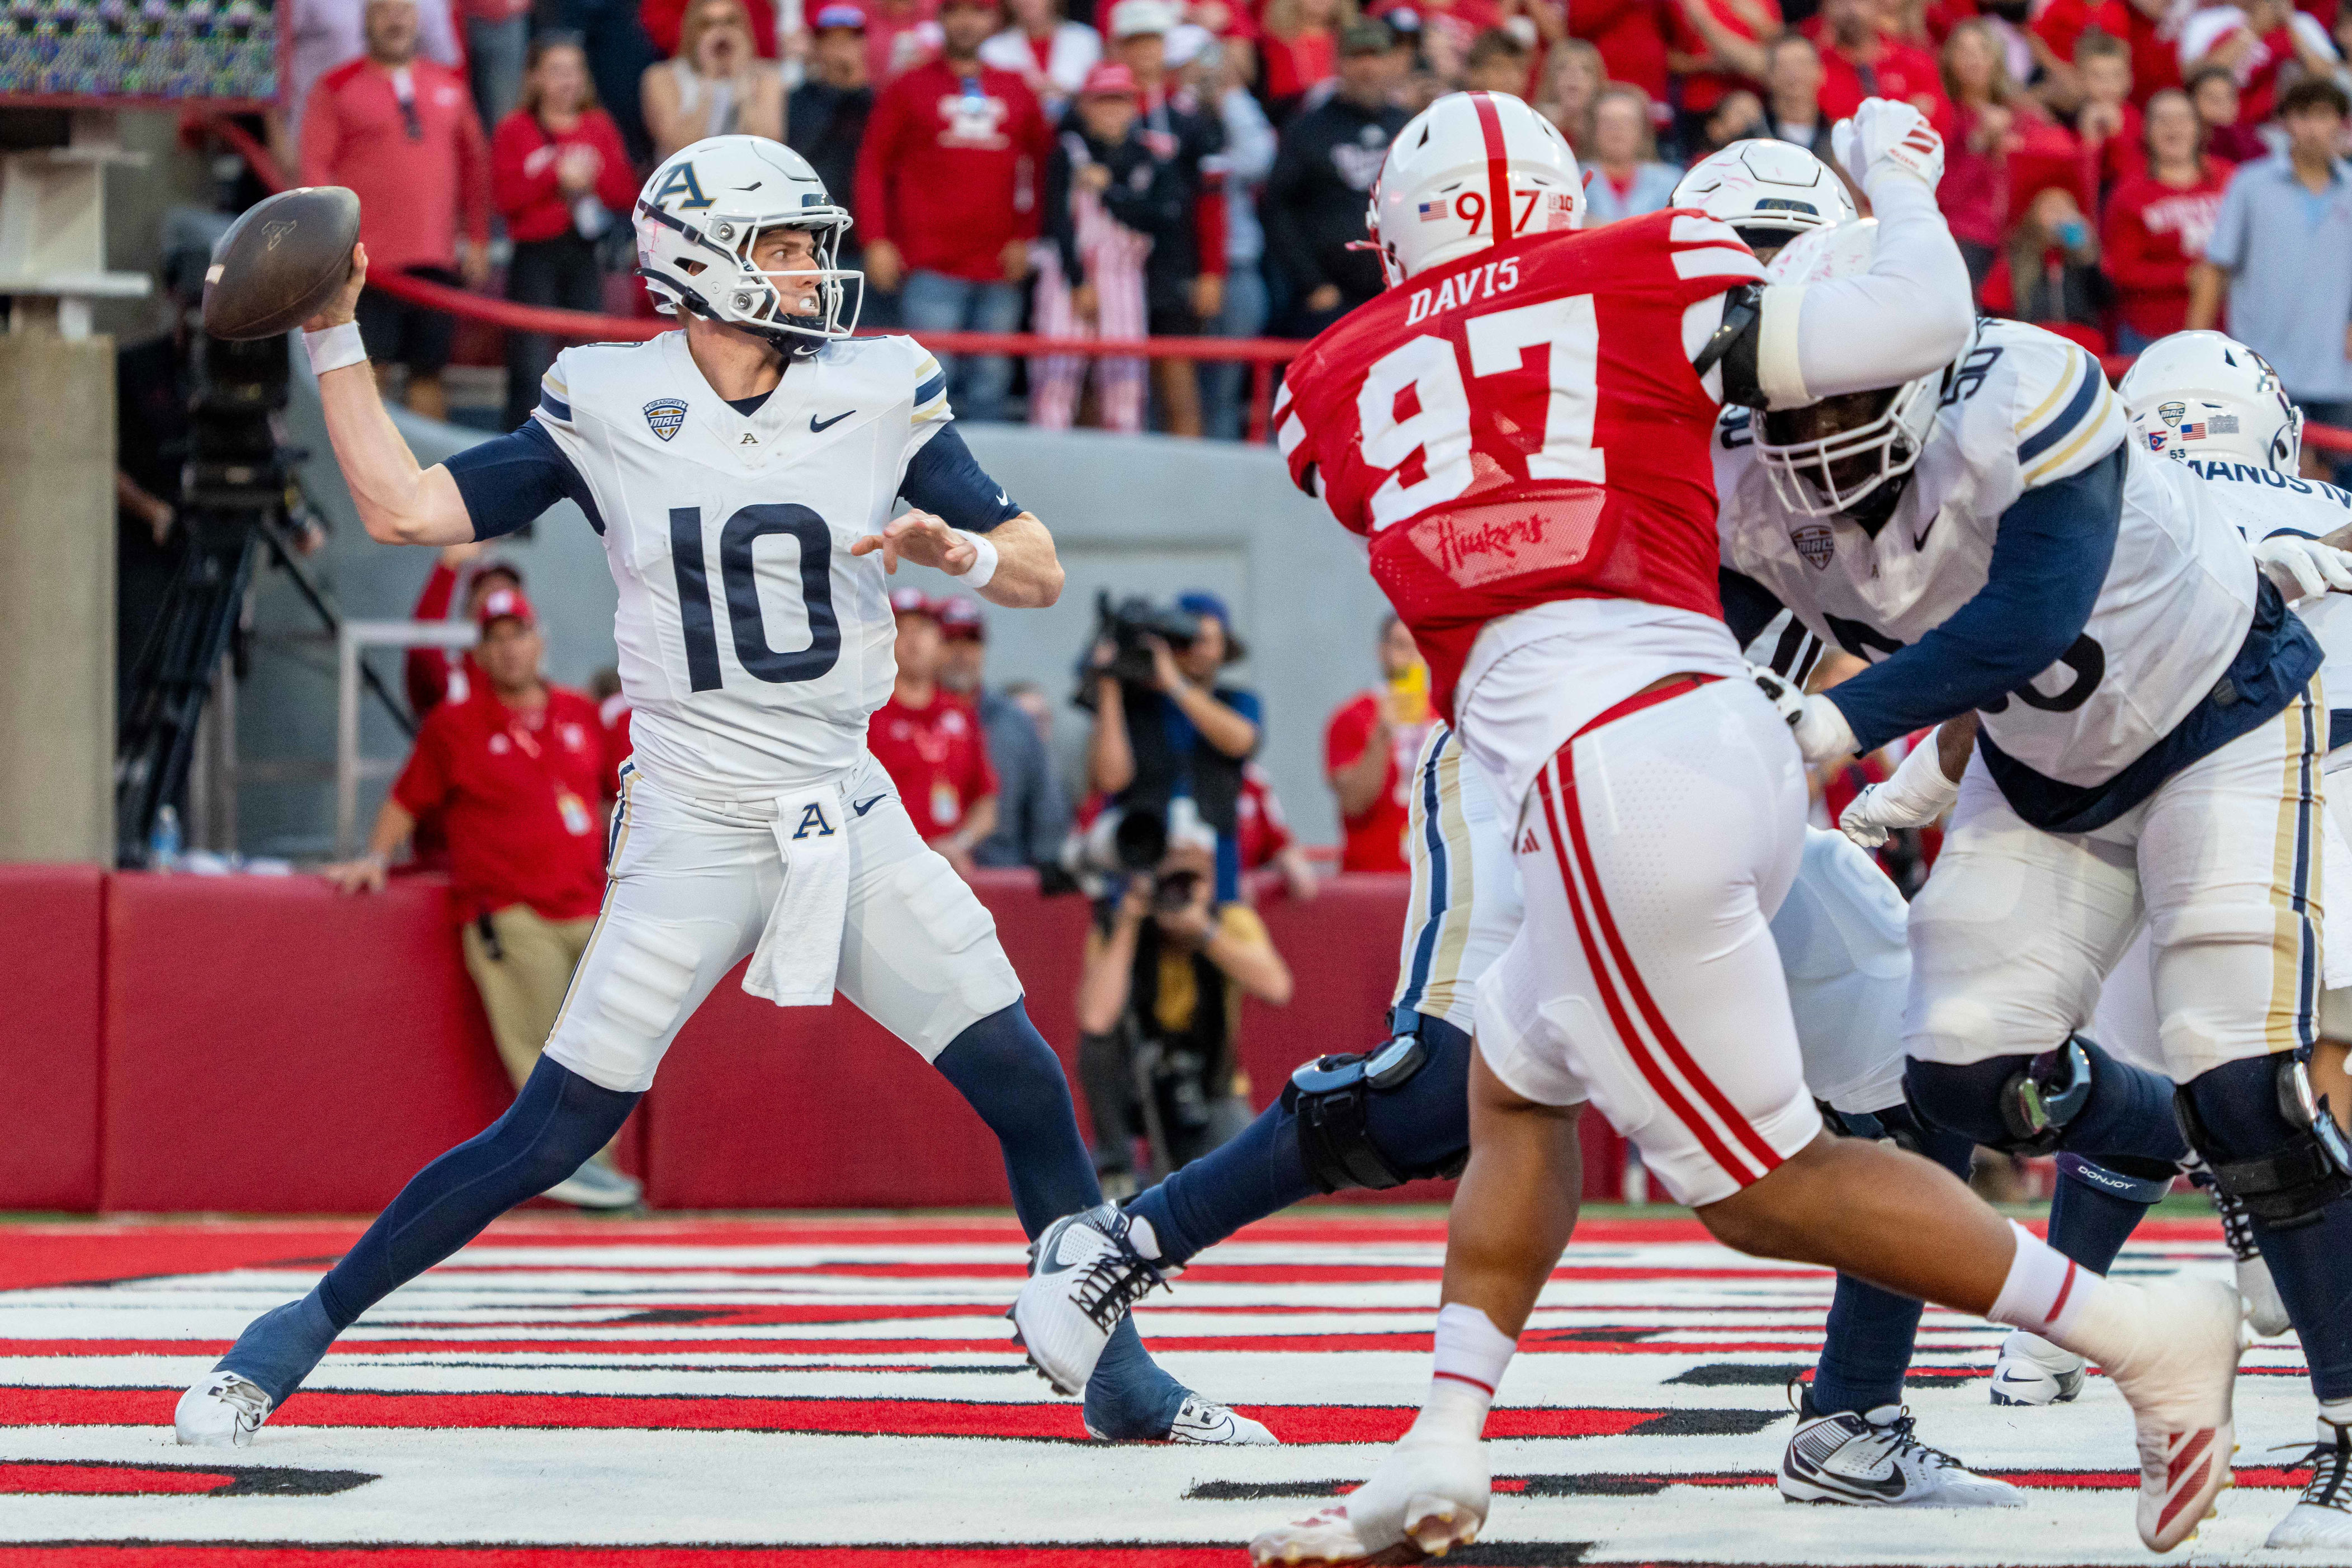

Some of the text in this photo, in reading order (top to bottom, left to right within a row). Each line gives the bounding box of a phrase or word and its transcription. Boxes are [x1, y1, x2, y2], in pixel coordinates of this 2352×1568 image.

[643, 160, 718, 220] A
[1405, 256, 1520, 327] DAVIS
[650, 399, 681, 408] GRADUATE
[1356, 293, 1607, 532] 97
[2160, 408, 2185, 419] MAC
[650, 415, 683, 428] MAC
[739, 432, 759, 444] A
[2169, 448, 2186, 460] 53
[669, 503, 842, 693] 10
[792, 801, 837, 840] A
[2077, 1165, 2134, 1189] DONJOY
